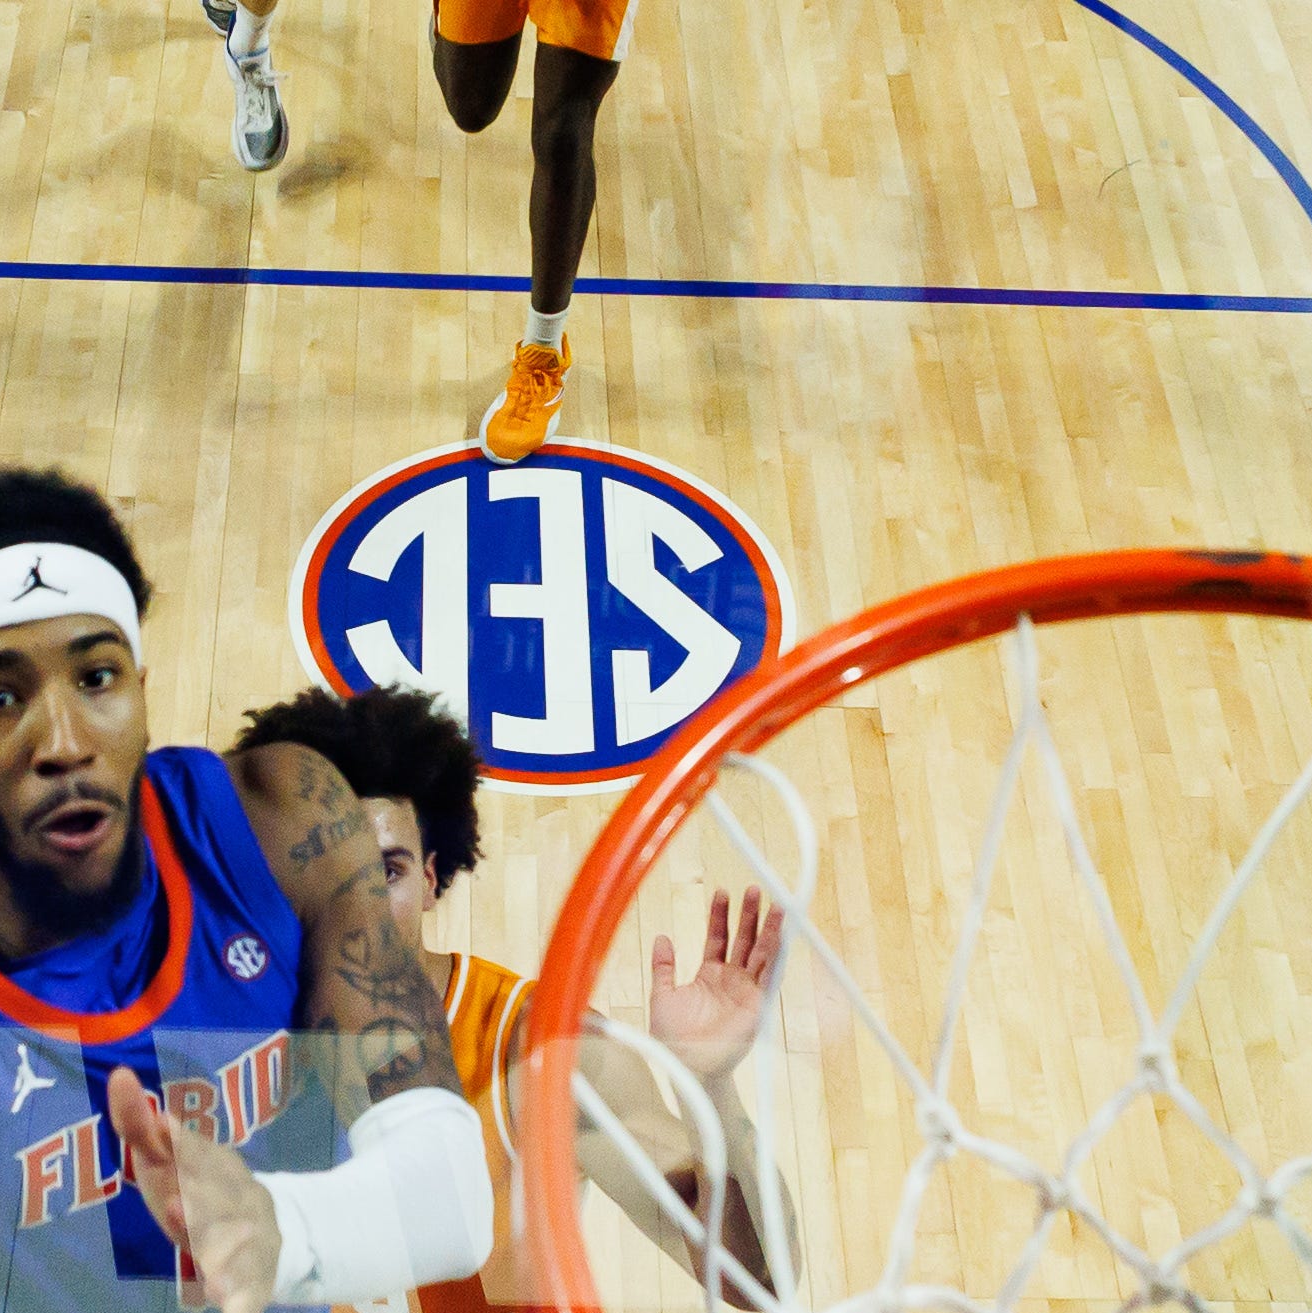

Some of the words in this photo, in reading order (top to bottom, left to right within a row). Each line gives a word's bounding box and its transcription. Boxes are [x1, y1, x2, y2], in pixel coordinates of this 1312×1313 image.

[346, 467, 741, 755] SEC
[228, 937, 265, 978] SEC
[16, 1029, 292, 1228] FLRID
